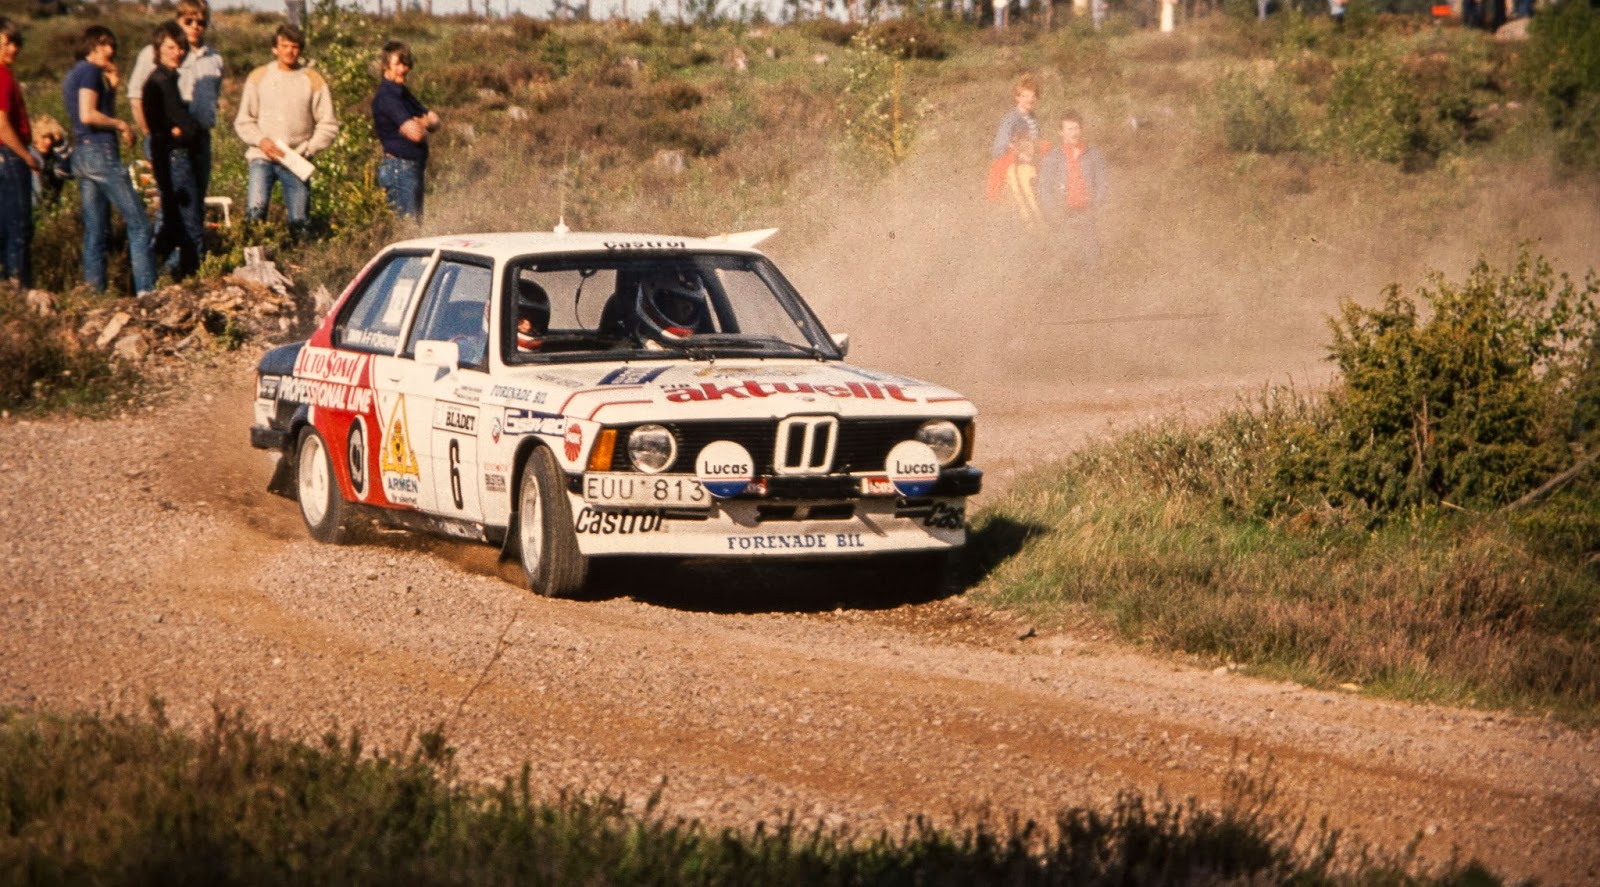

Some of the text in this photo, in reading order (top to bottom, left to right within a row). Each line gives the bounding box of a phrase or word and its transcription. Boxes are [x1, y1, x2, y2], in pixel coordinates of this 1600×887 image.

[346, 385, 373, 414] LINE
[664, 380, 918, 404] aktuellt
[446, 411, 476, 431] BLADET
[449, 437, 464, 511] 6
[704, 460, 749, 476] Lucas
[896, 459, 937, 475] Lucas
[587, 478, 705, 502] EUU 813
[575, 506, 664, 535] Castrol
[838, 533, 865, 547] BIL
